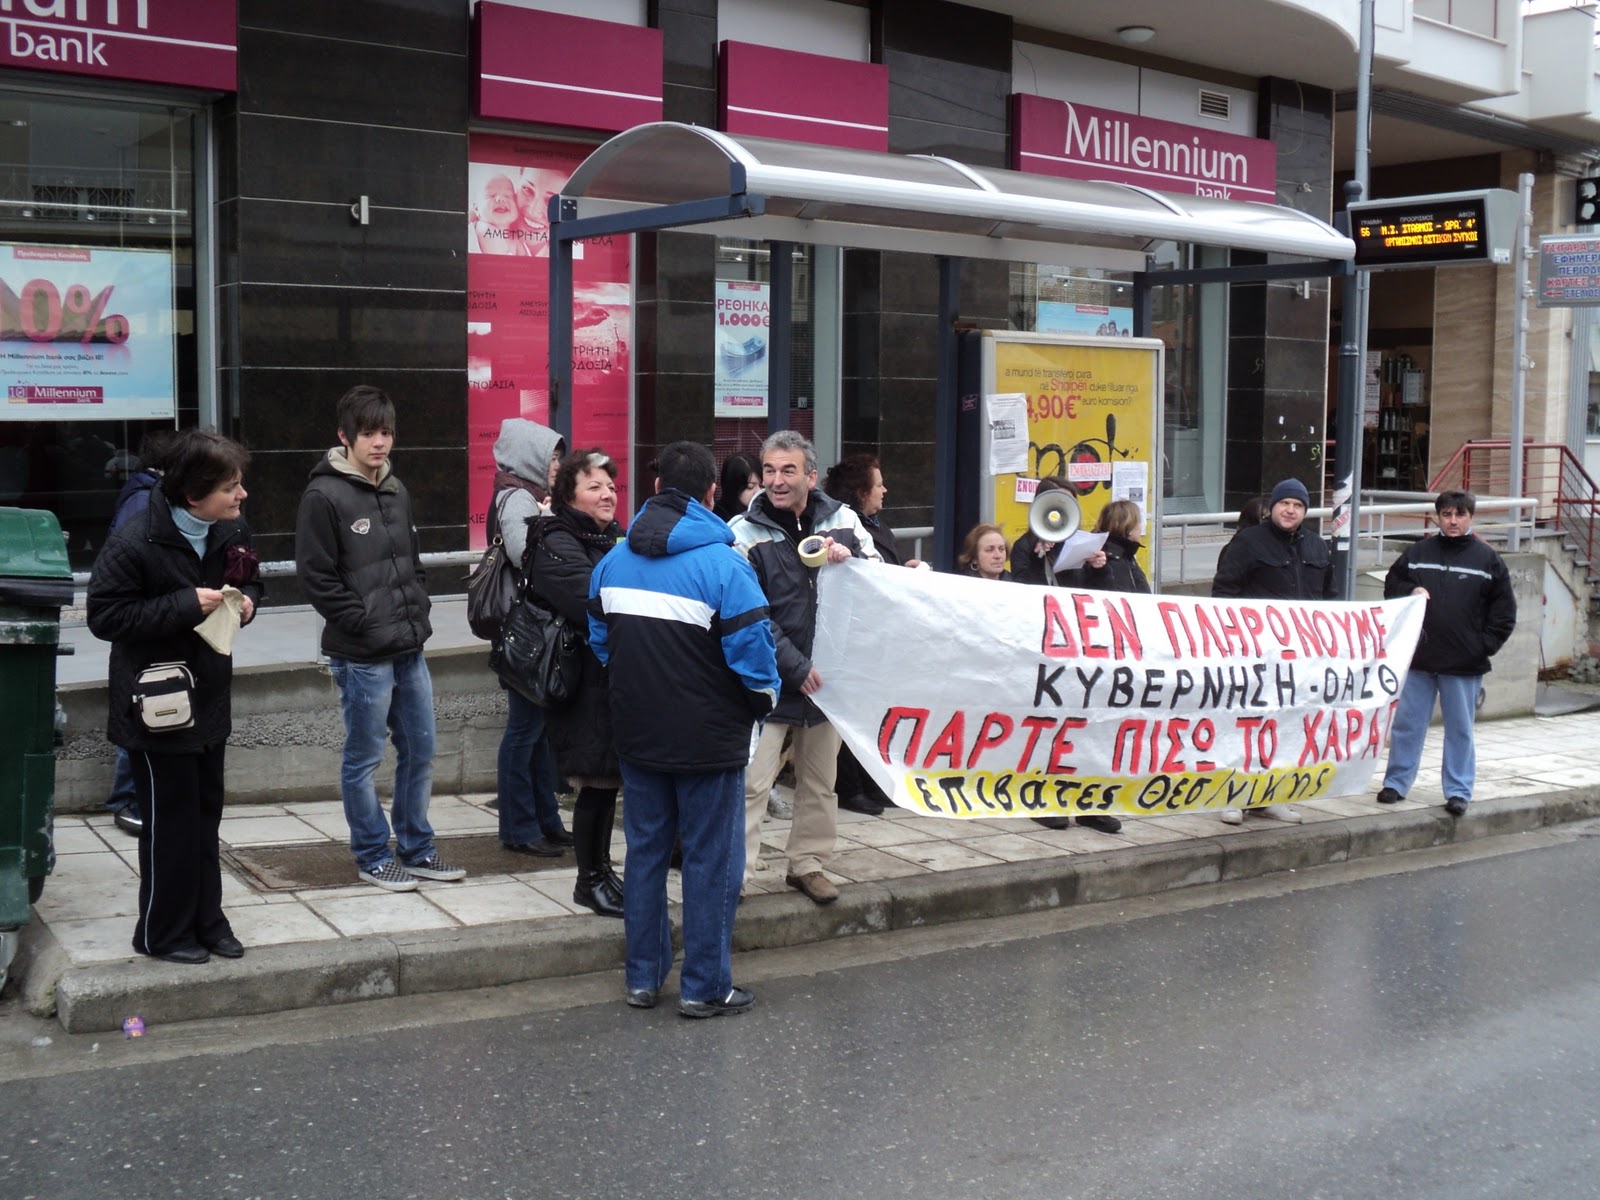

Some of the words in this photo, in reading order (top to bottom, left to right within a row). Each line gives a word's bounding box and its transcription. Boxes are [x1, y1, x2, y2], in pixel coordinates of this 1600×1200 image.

[10, 22, 108, 66] bank
[1064, 101, 1248, 183] Millennium
[1195, 182, 1232, 200] bank
[1400, 214, 1433, 223] ΠΡΟΟΡΙΣΜΟΣ
[483, 228, 549, 242] ΑΜΕΤΡΗΤΑ
[1360, 227, 1371, 237] 56
[1402, 222, 1434, 234] ΣΤΑΘΜΟΣ
[1385, 235, 1423, 247] ΟΡΓΑΝΙΣΜΟΣ
[1544, 242, 1588, 254] ΤΣΙΓΑΡΑ
[1547, 276, 1588, 287] ΚΑΡΤΕΣ
[468, 291, 496, 299] ΤΡΗΤΗ
[520, 300, 549, 308] ΑΜΕΤΡΗ
[519, 309, 549, 317] ΑΙΣΙΟΔΟ
[572, 345, 610, 356] ΤΡΗΤΗ
[571, 359, 612, 371] ΟΔΟΞΙΑ
[1012, 368, 1033, 377] mund
[1076, 370, 1092, 380] para
[468, 380, 515, 390] ΓΝΟΙΑΣΙΑ
[34, 386, 97, 398] Millennium
[1041, 593, 1143, 662] ΔΕΝ
[1161, 601, 1387, 661] ΠΛΗΡΩΝΟΥΜΕ
[1033, 662, 1296, 709] ΚΥΒΕΡΝΗΣΗ
[877, 706, 1088, 776] ΠΑΡΤΕ
[1111, 716, 1216, 776] ΠΙΣΩ
[1235, 716, 1278, 774] ΤΟ
